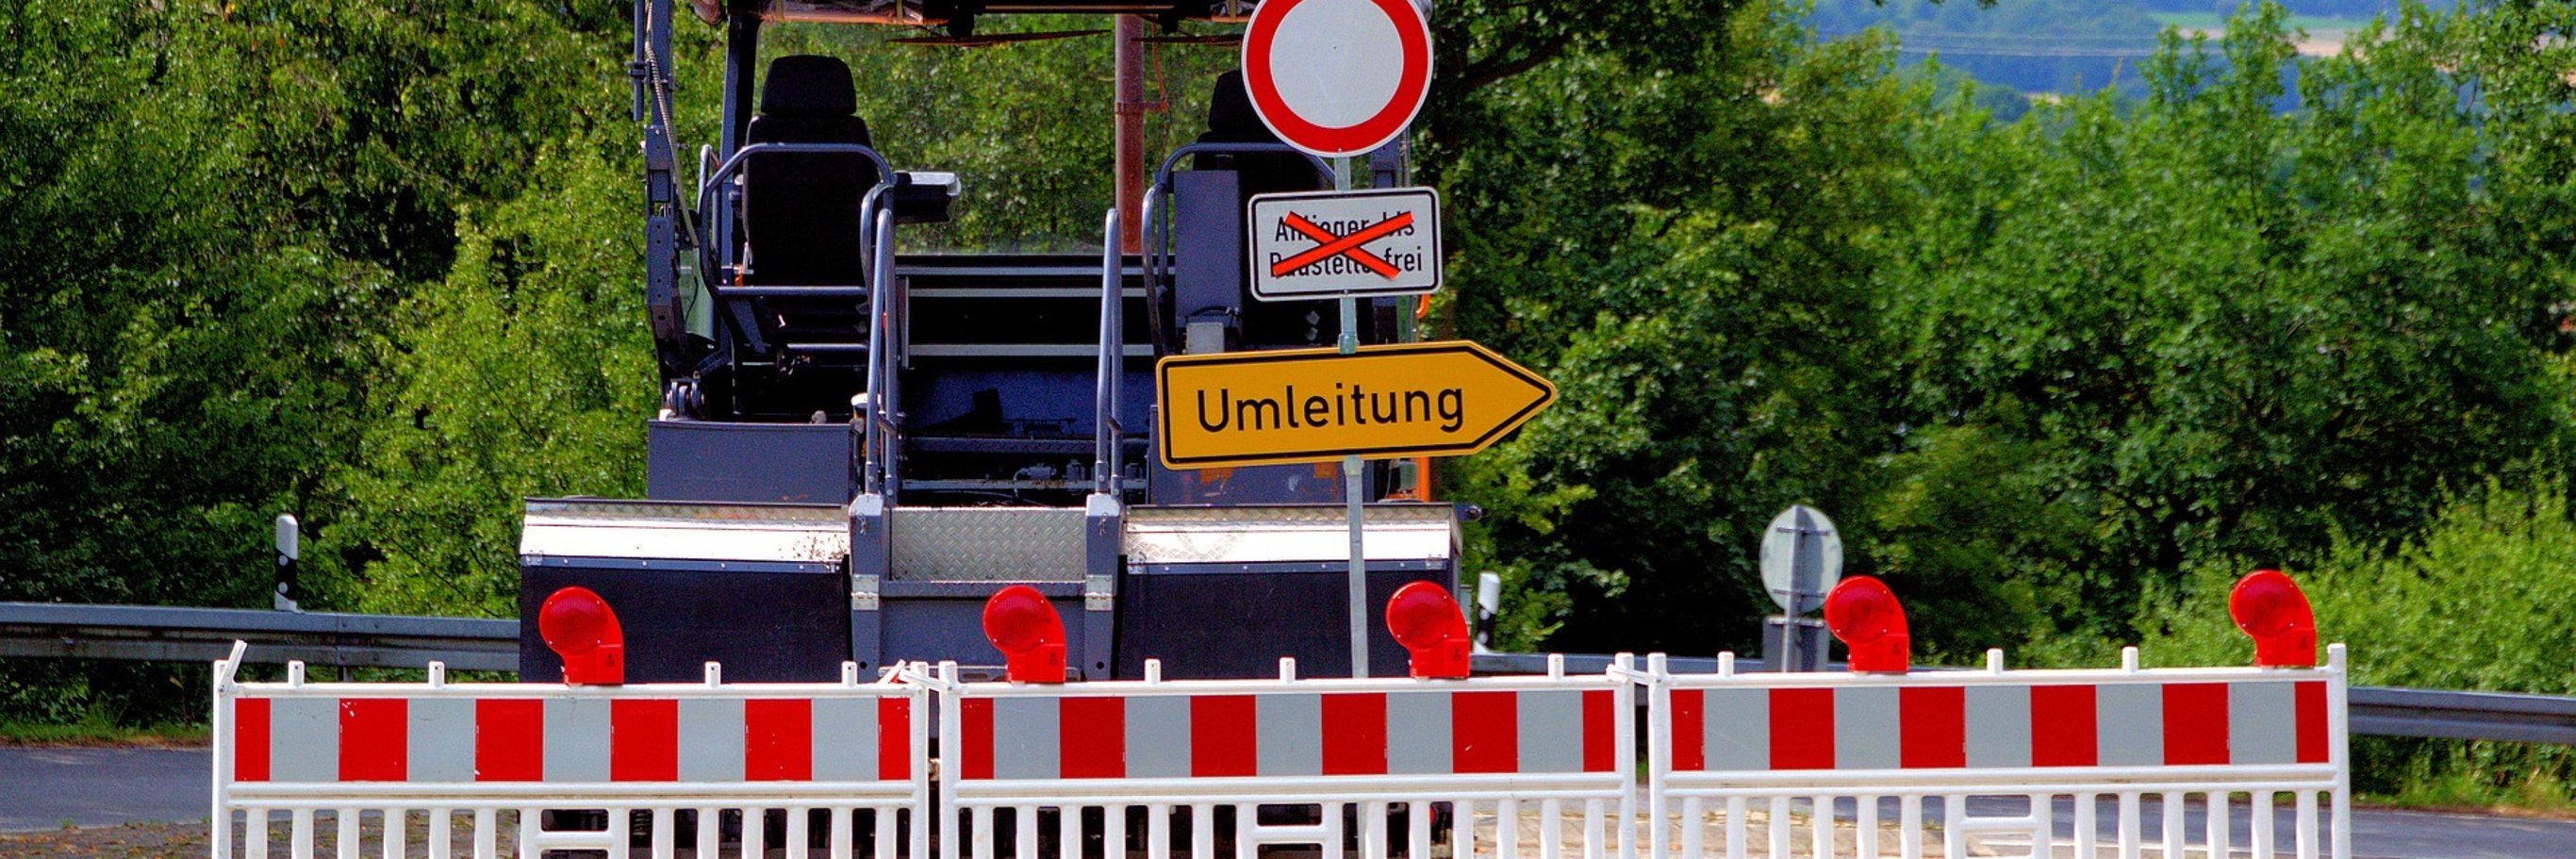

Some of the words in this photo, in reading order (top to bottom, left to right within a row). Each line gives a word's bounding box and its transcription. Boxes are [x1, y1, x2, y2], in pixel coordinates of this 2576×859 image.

[1275, 213, 1370, 243] Aneger
[1270, 250, 1373, 277] Bustell
[1384, 245, 1422, 272] frei
[1197, 382, 1463, 433] Umleitung
